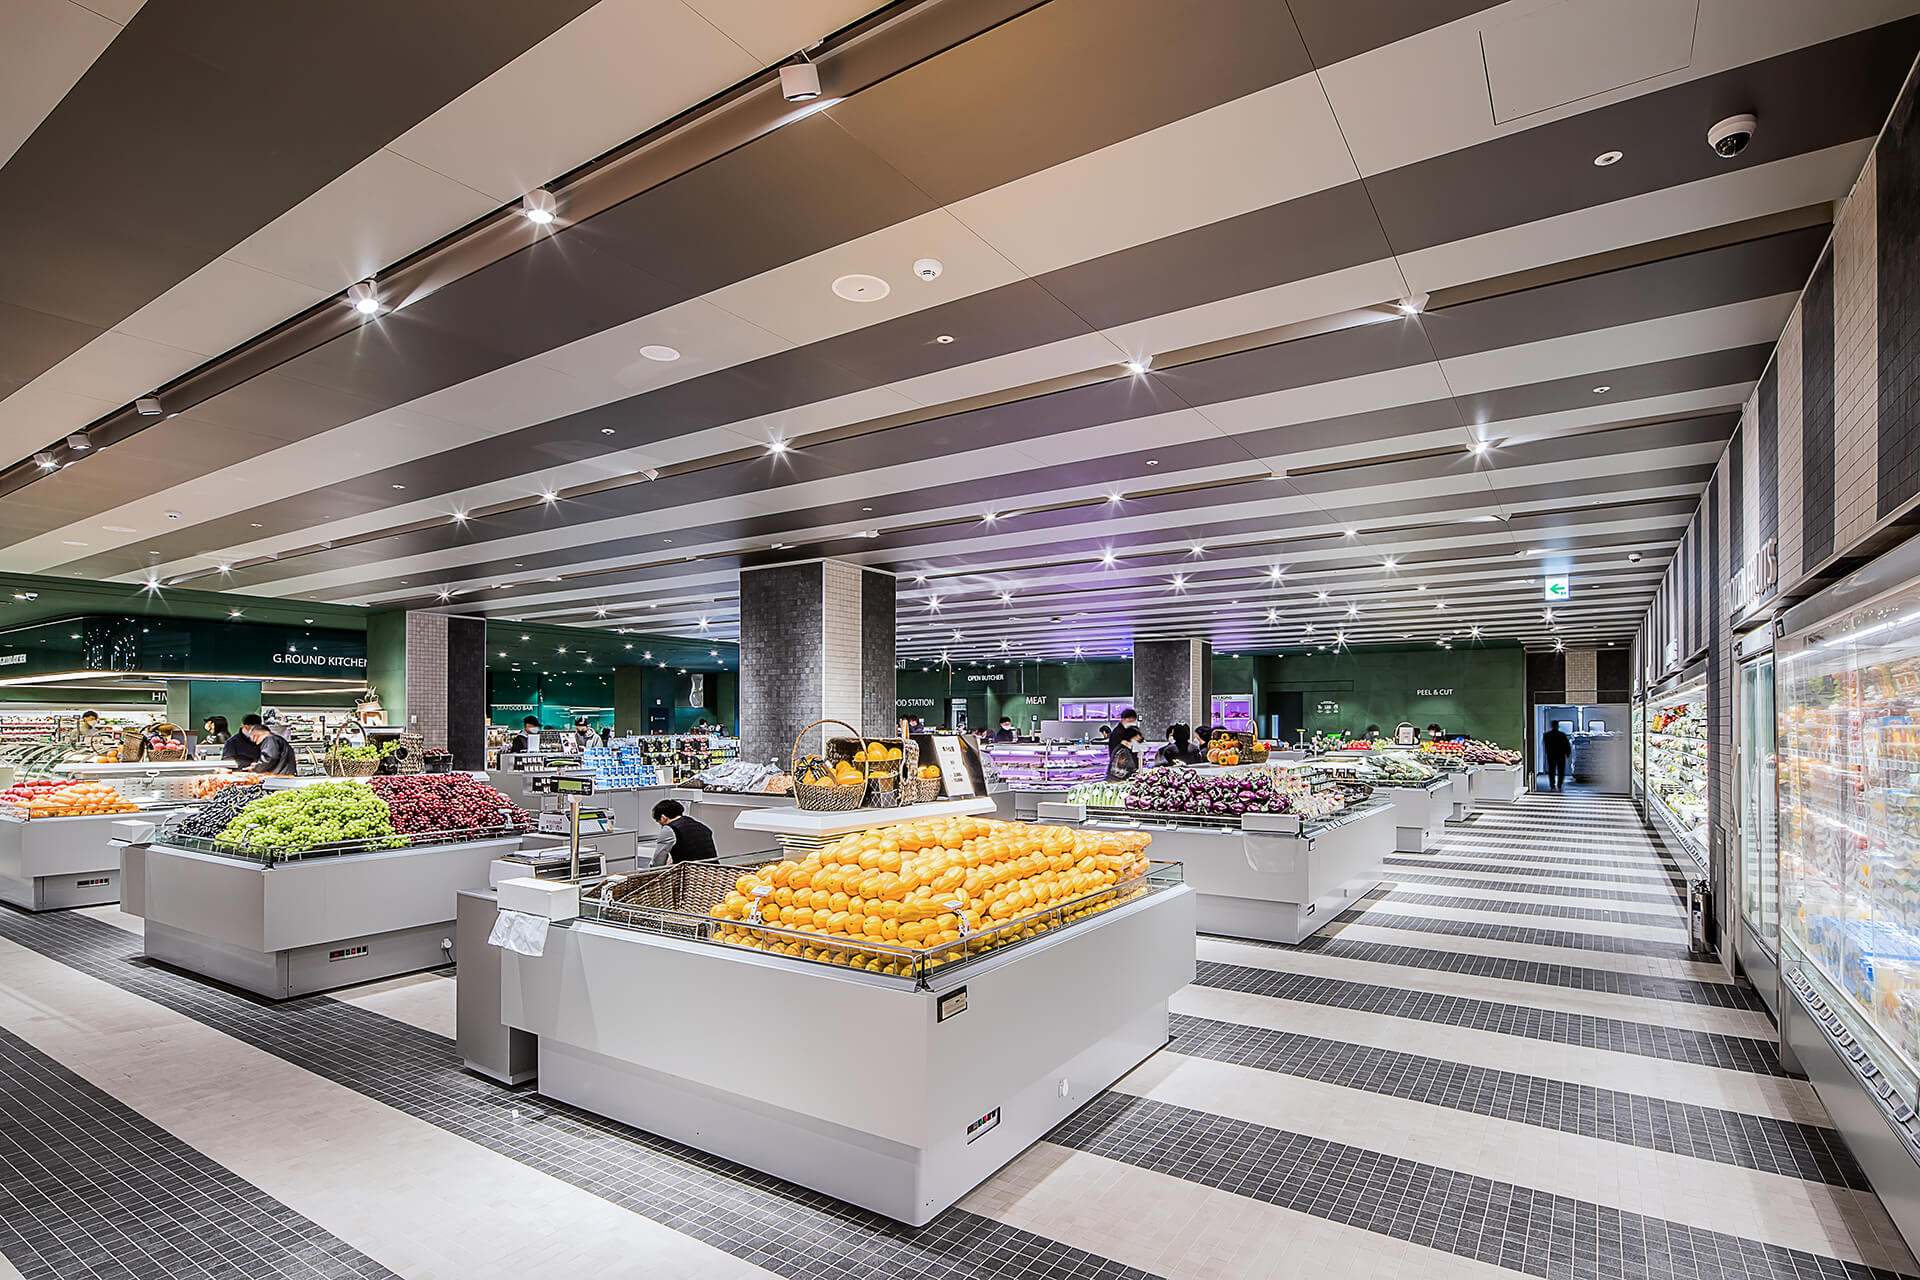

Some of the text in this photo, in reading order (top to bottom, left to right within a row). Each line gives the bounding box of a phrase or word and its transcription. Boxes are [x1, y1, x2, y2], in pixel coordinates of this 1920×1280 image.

[273, 653, 326, 666] G.ROUND
[1439, 688, 1454, 696] CUT
[907, 699, 935, 707] STATION
[1025, 696, 1047, 705] MEAT
